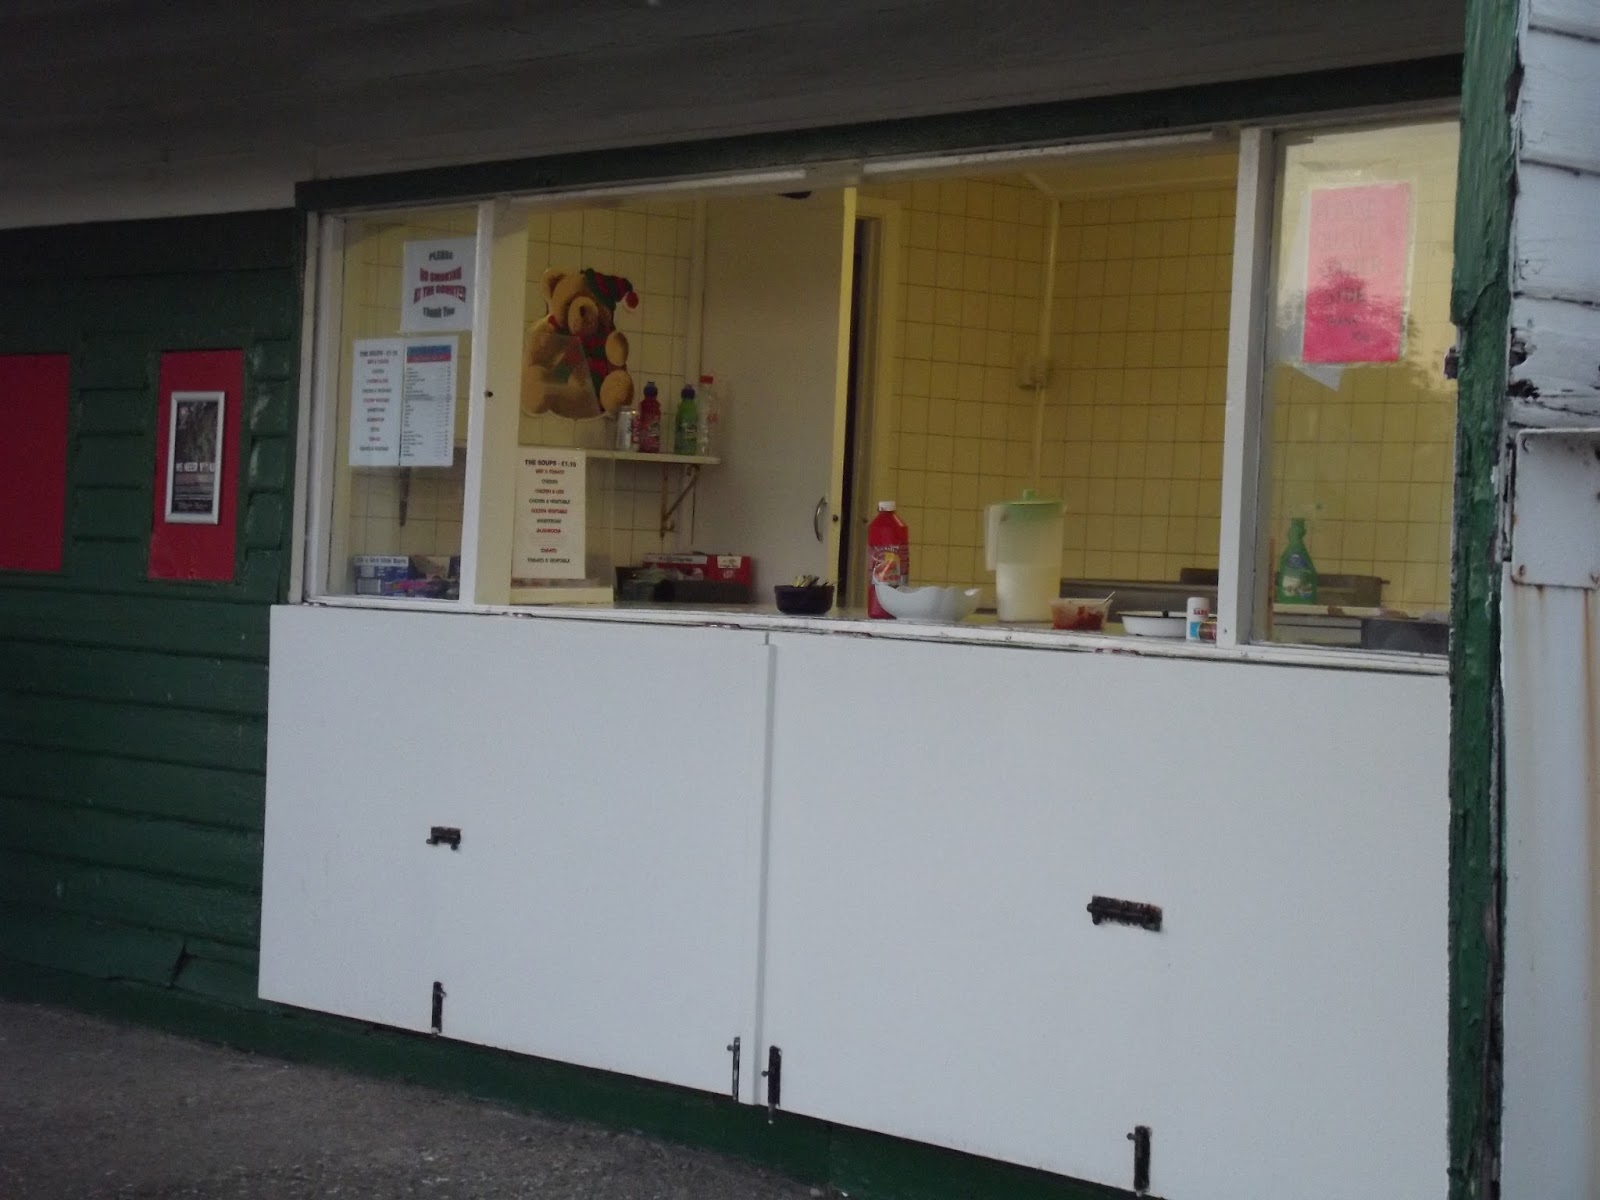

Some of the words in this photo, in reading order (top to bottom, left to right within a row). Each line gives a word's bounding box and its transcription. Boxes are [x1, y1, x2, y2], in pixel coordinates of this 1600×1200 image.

[419, 267, 429, 282] NO
[430, 266, 462, 282] SMOKING
[413, 287, 421, 304] AT
[422, 286, 434, 298] THE
[435, 285, 466, 303] COUNTER
[524, 459, 536, 467] THE
[537, 459, 557, 467] SOUPS
